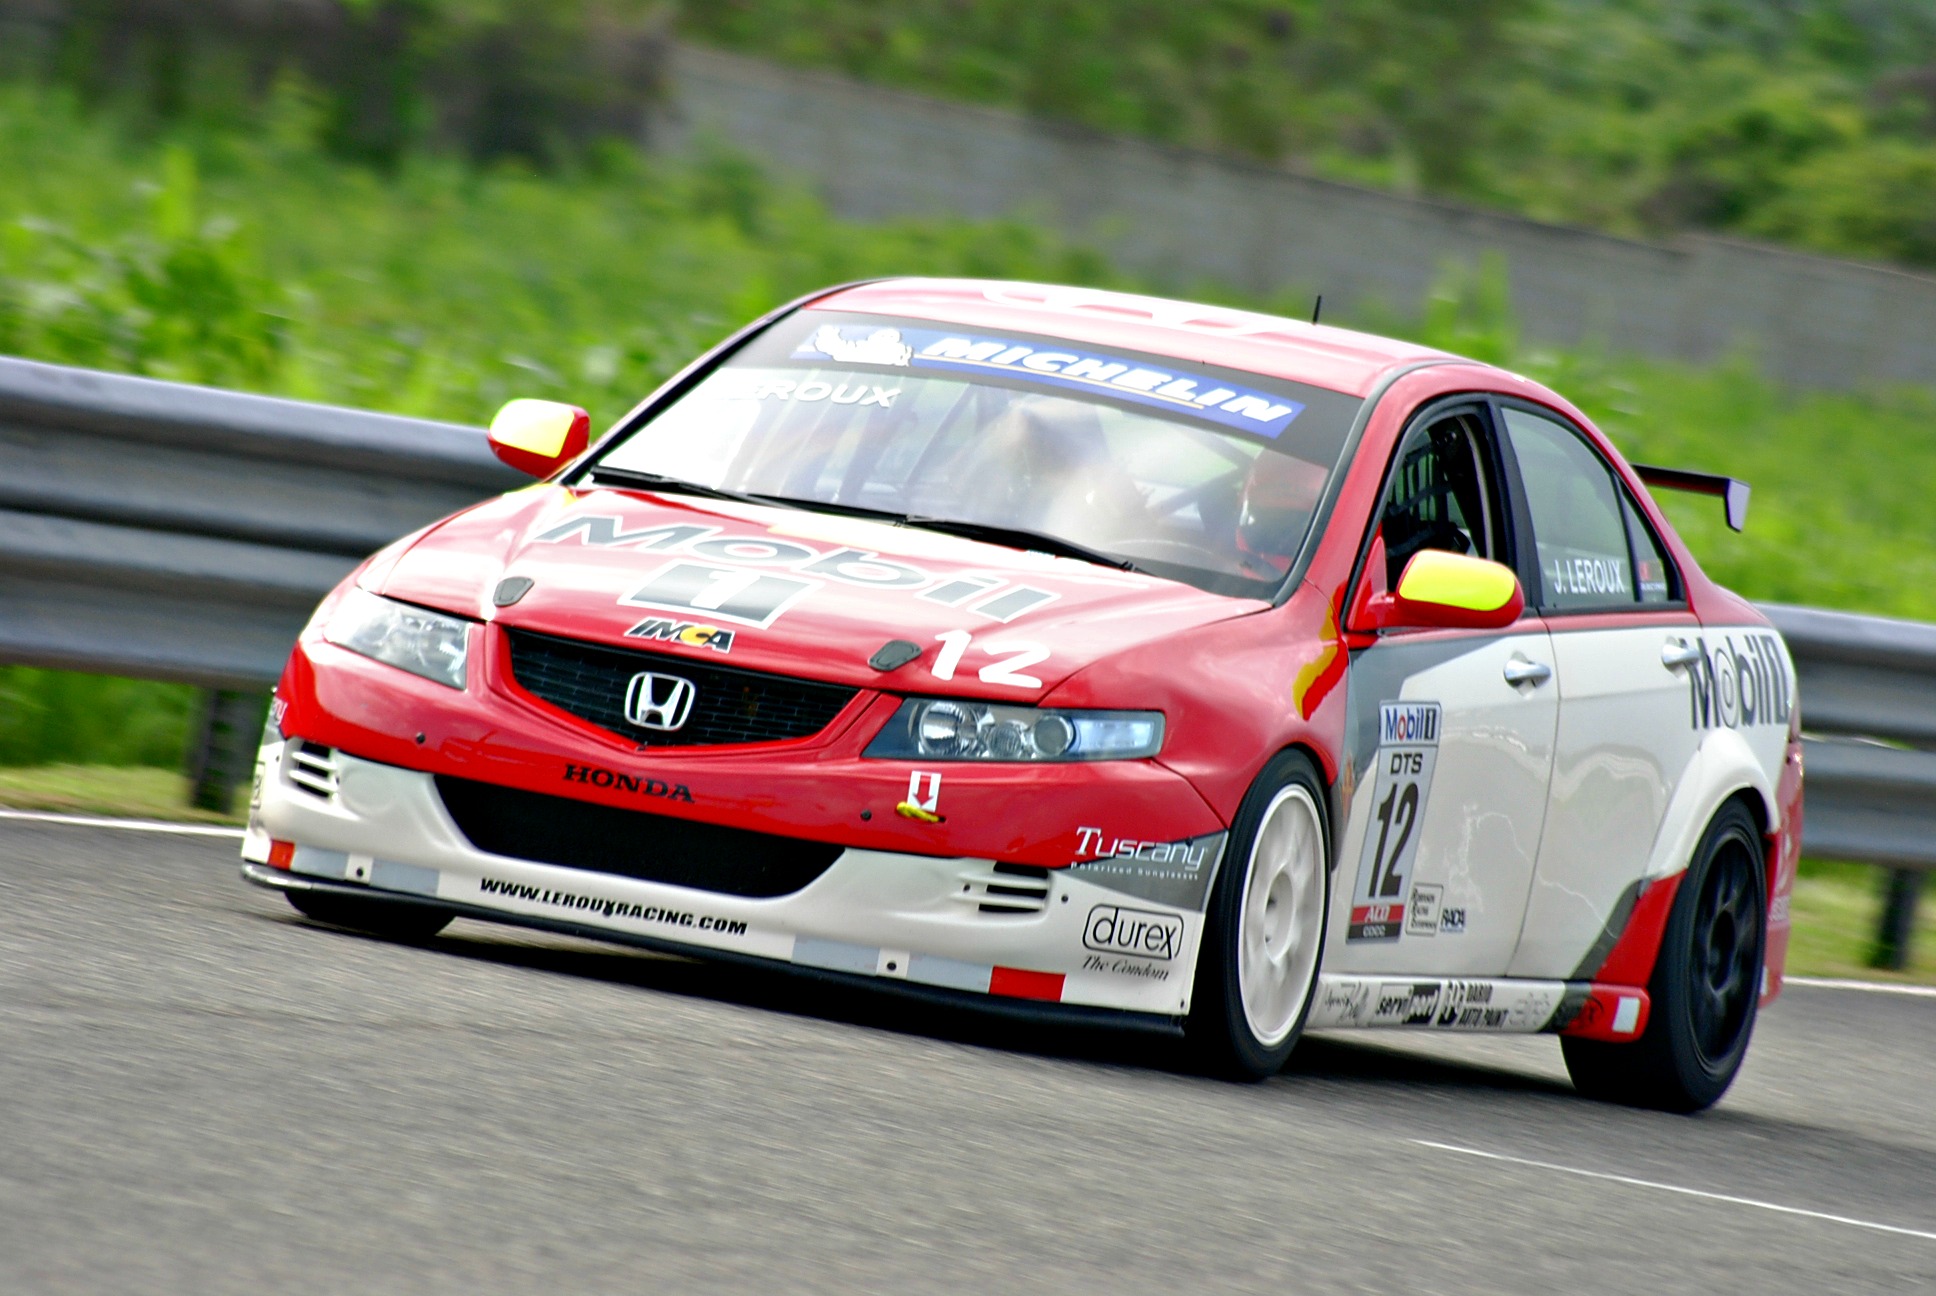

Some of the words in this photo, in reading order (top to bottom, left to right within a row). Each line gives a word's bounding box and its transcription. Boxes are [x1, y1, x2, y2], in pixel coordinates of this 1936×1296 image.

[926, 336, 1293, 423] MICHELIN
[533, 515, 1061, 623] Mobil
[1553, 560, 1567, 593] J.
[1567, 558, 1626, 594] LEROUX
[626, 618, 734, 652] IMCA
[930, 629, 1051, 688] 12
[1385, 707, 1424, 741] Mobil
[563, 763, 695, 803] HONDA
[1390, 753, 1423, 775] DTS
[1075, 826, 1204, 871] Tuscany
[1368, 782, 1419, 898] 12
[480, 878, 748, 935] WWW.LEROUXRACING.COM
[1092, 908, 1177, 960] durex
[1082, 955, 1108, 971] The
[1111, 959, 1170, 982] Condom
